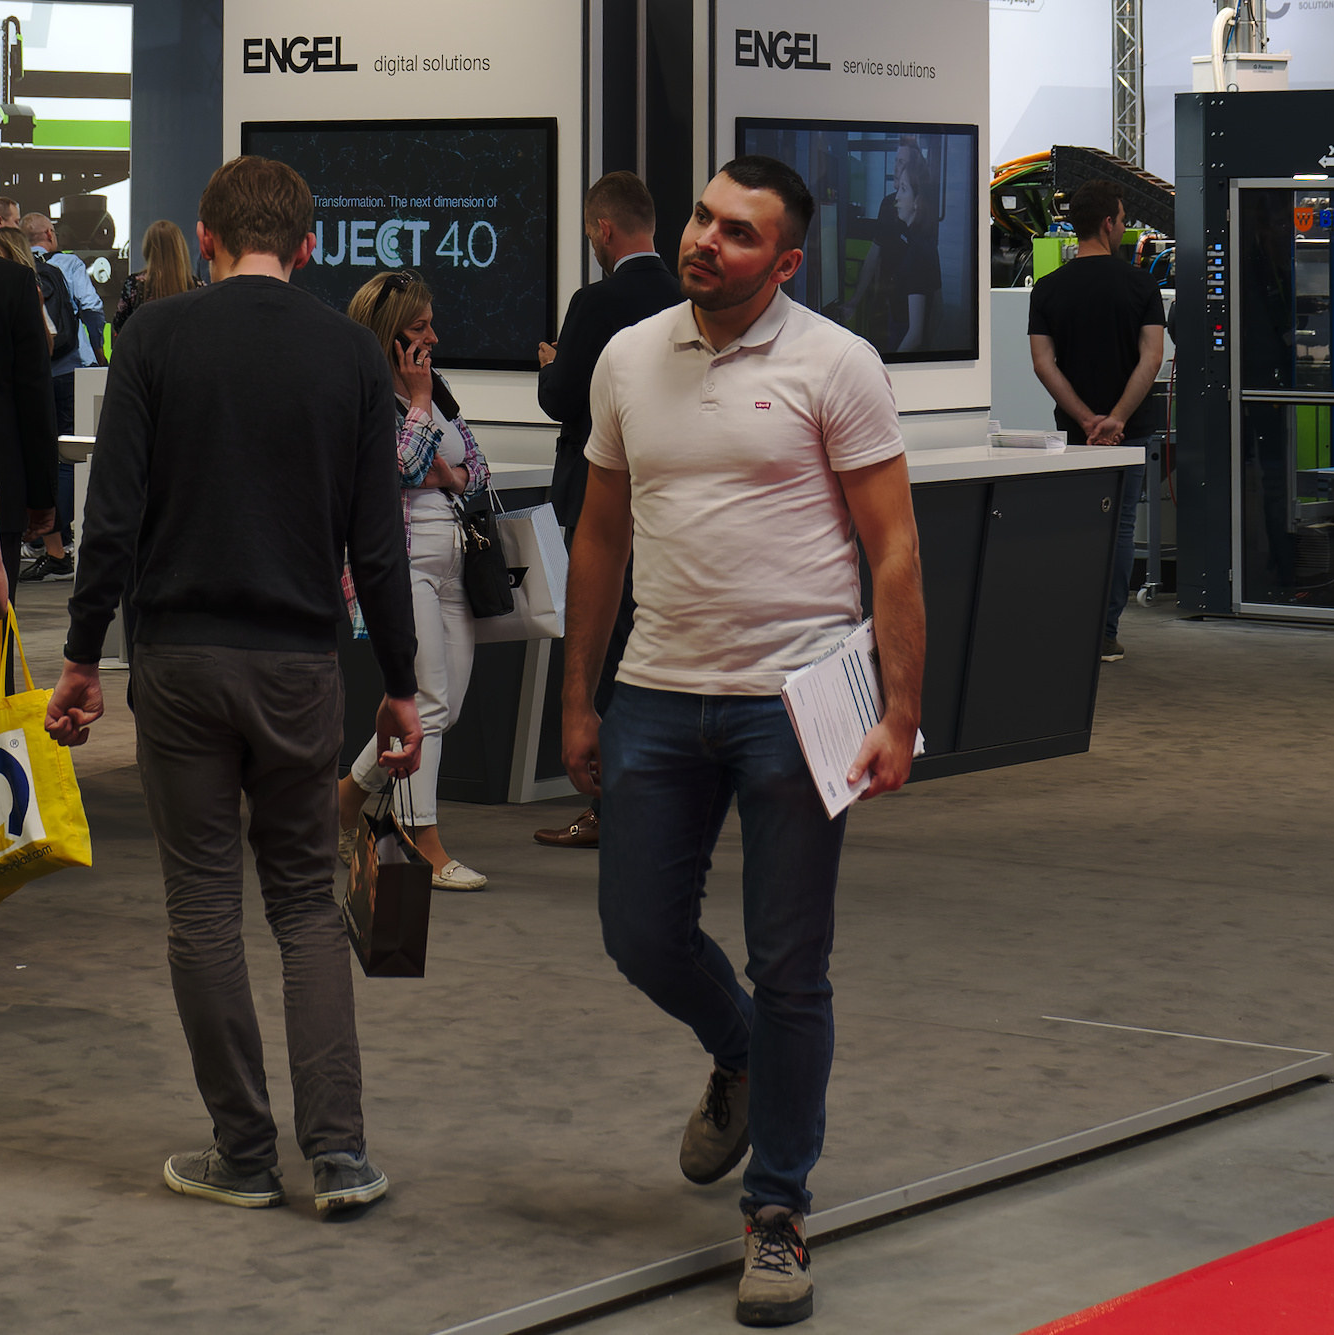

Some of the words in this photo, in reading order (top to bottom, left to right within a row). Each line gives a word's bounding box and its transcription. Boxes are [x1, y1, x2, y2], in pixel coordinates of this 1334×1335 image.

[1298, 0, 1334, 10] SOLUTION
[243, 36, 358, 74] ENGEL
[373, 55, 418, 76] digital
[422, 54, 491, 72] solutions
[735, 29, 831, 71] ENGEL
[842, 58, 884, 76] service
[886, 60, 936, 80] solutions
[312, 195, 386, 208] Transformation.
[388, 195, 408, 208] The
[409, 196, 431, 208] next
[433, 195, 486, 208] dimension
[486, 195, 498, 208] of
[435, 220, 498, 268] 4.0
